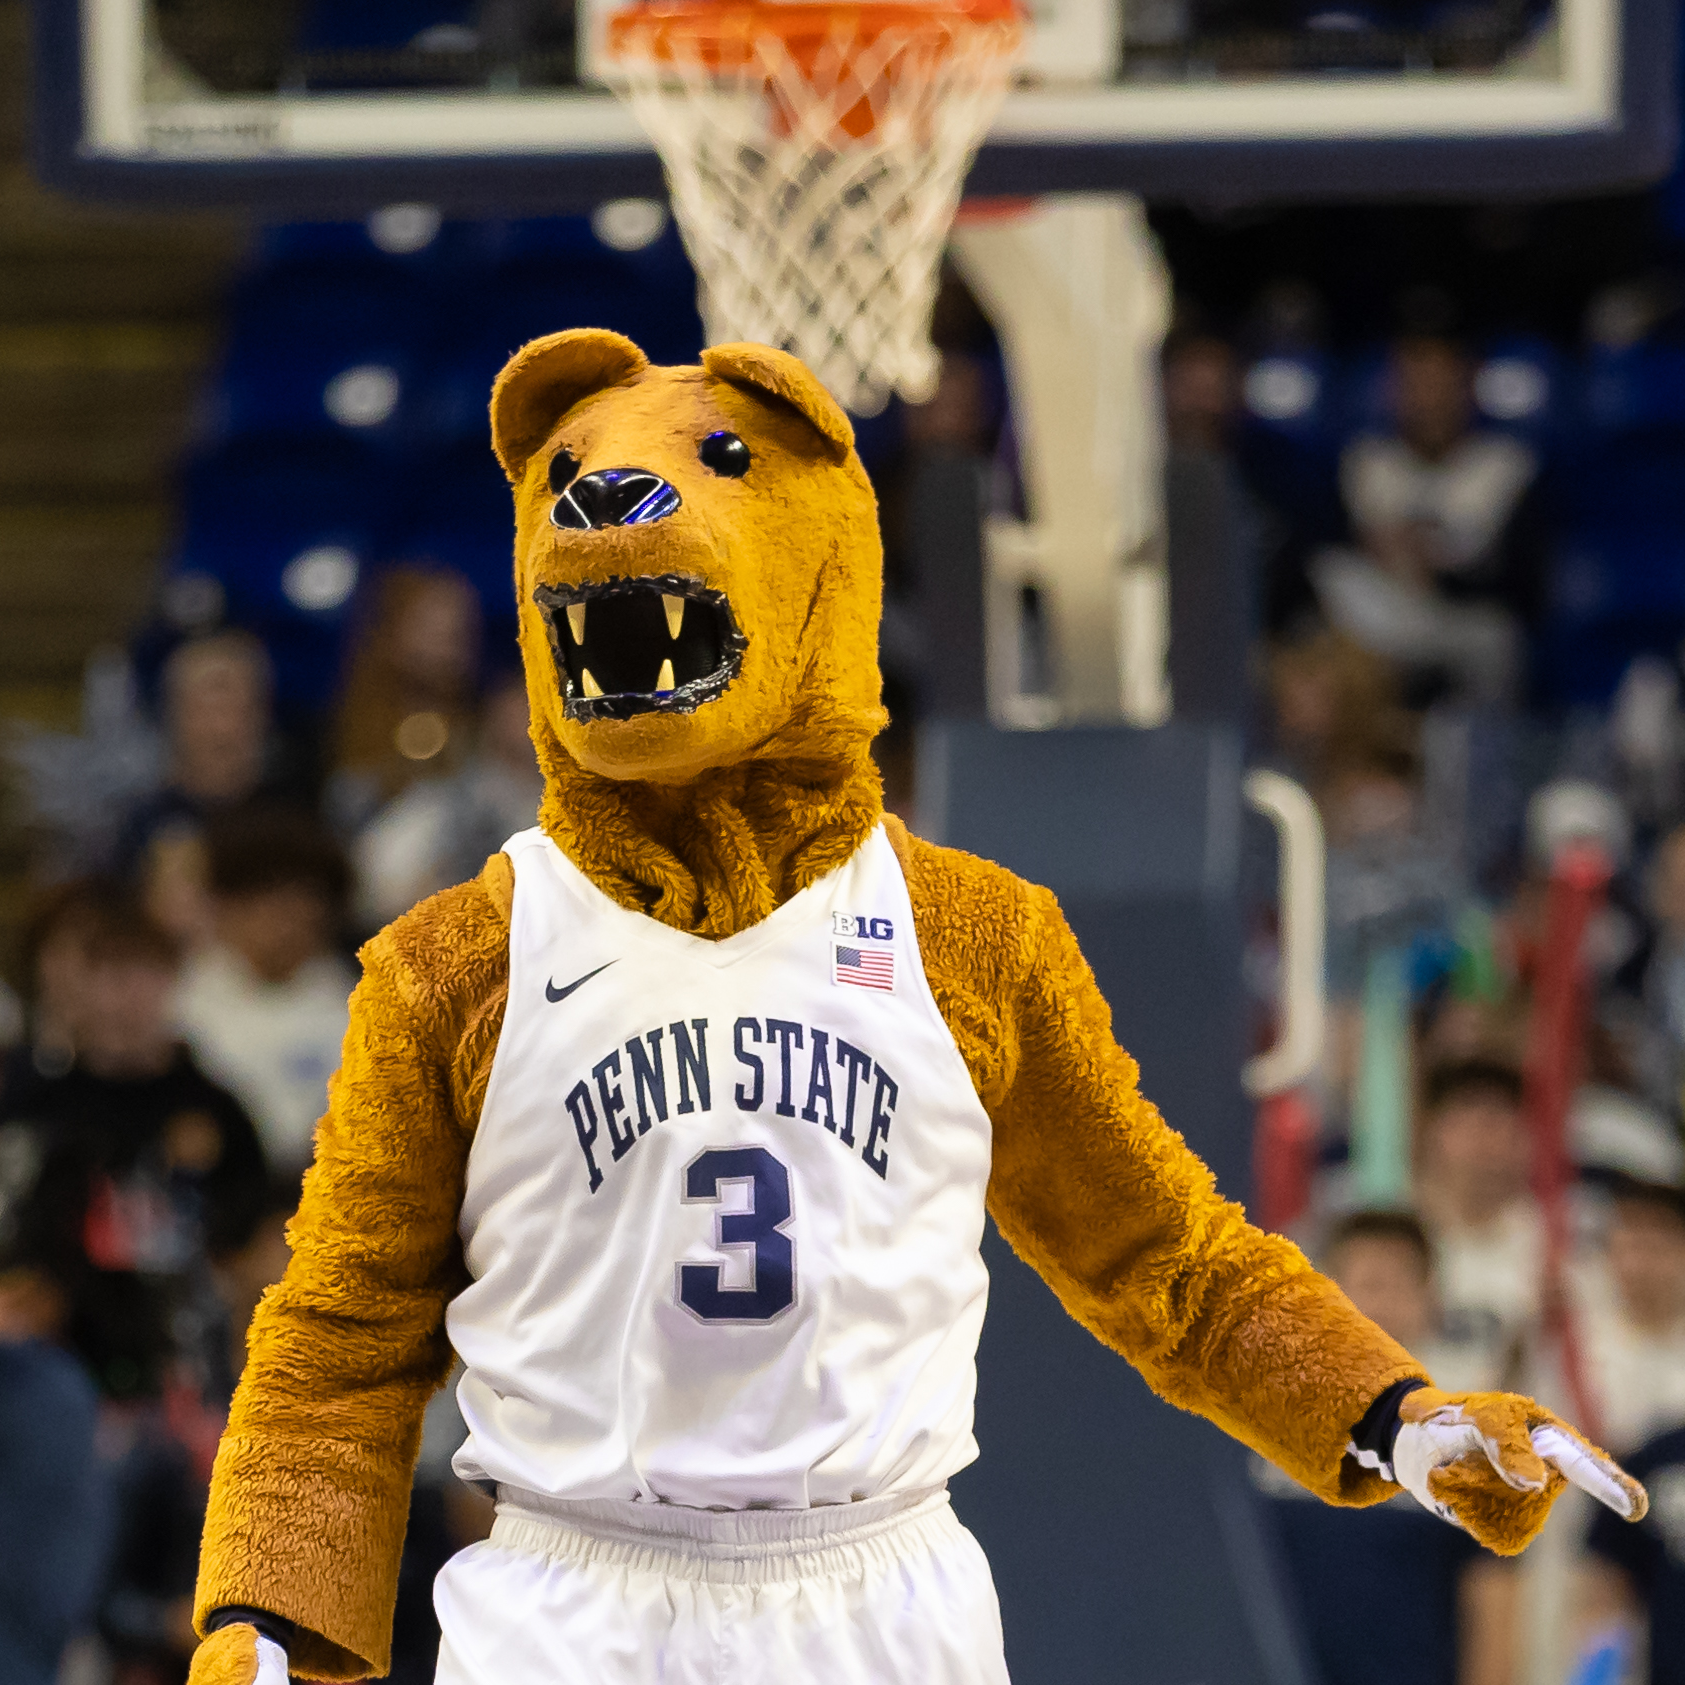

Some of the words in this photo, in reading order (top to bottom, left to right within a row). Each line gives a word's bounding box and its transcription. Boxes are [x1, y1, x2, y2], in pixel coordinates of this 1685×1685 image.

[564, 1017, 712, 1195] PENN
[733, 1016, 899, 1181] STATE
[674, 1145, 799, 1327] 3
